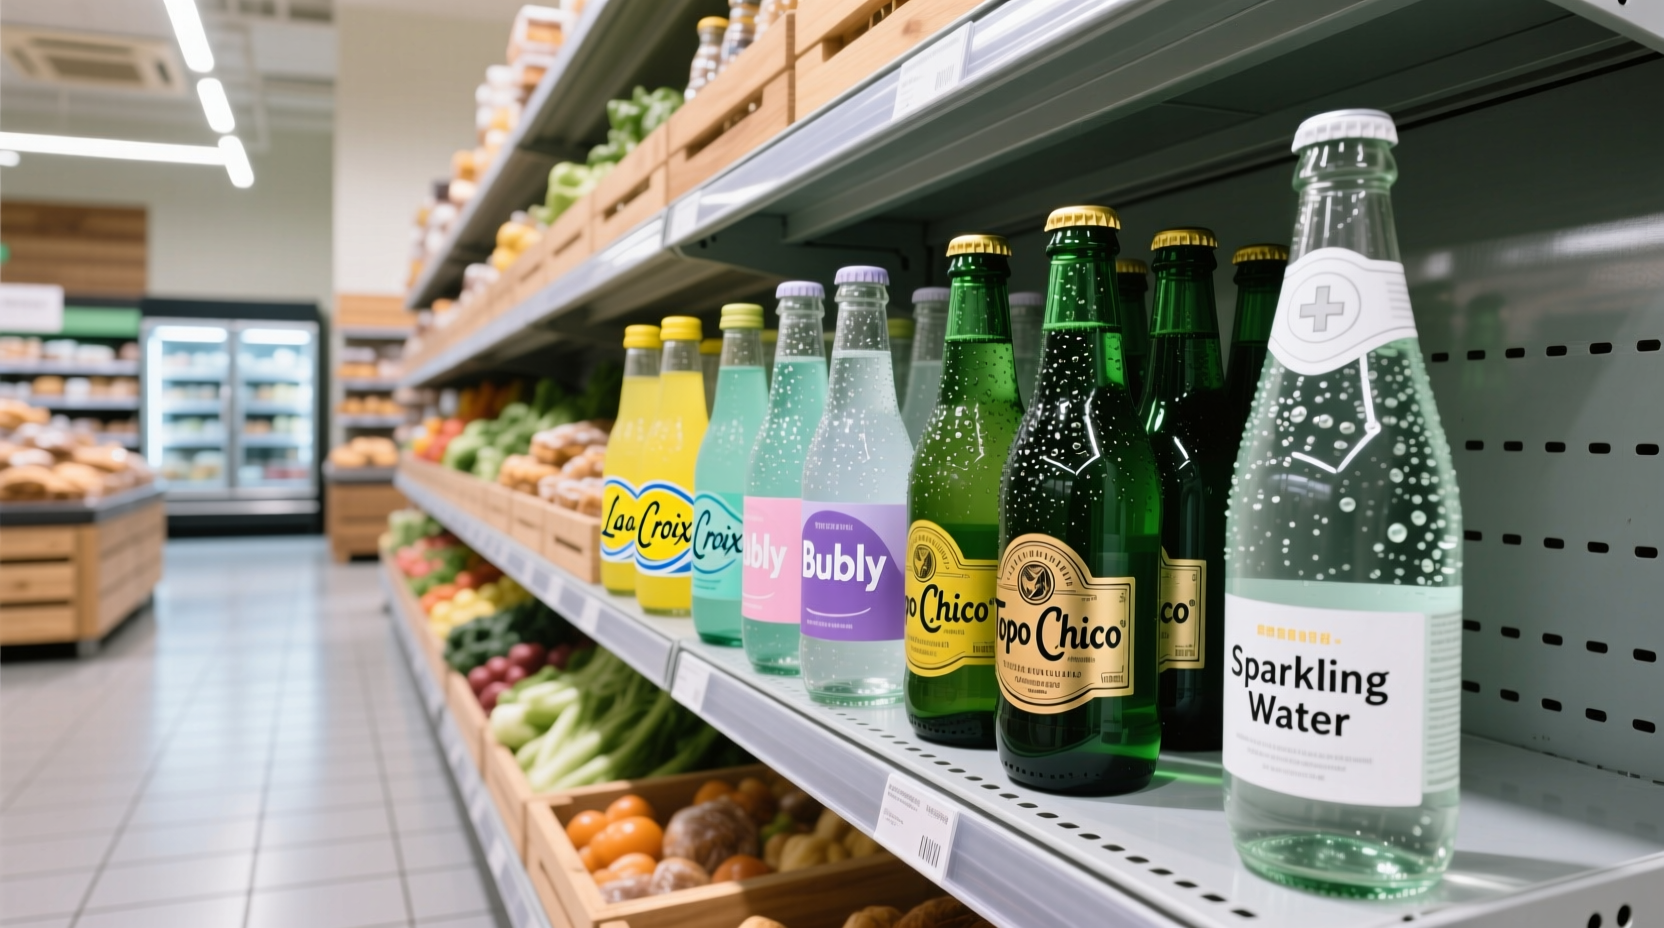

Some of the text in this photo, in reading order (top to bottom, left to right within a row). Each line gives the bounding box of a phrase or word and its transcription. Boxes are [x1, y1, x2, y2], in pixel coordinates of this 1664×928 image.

[638, 501, 693, 548] Croix
[693, 509, 743, 560] Croix
[802, 539, 887, 592] Bubly
[995, 598, 1031, 654] Topo
[1231, 644, 1389, 706] Sparkling
[1248, 690, 1350, 736] Water
